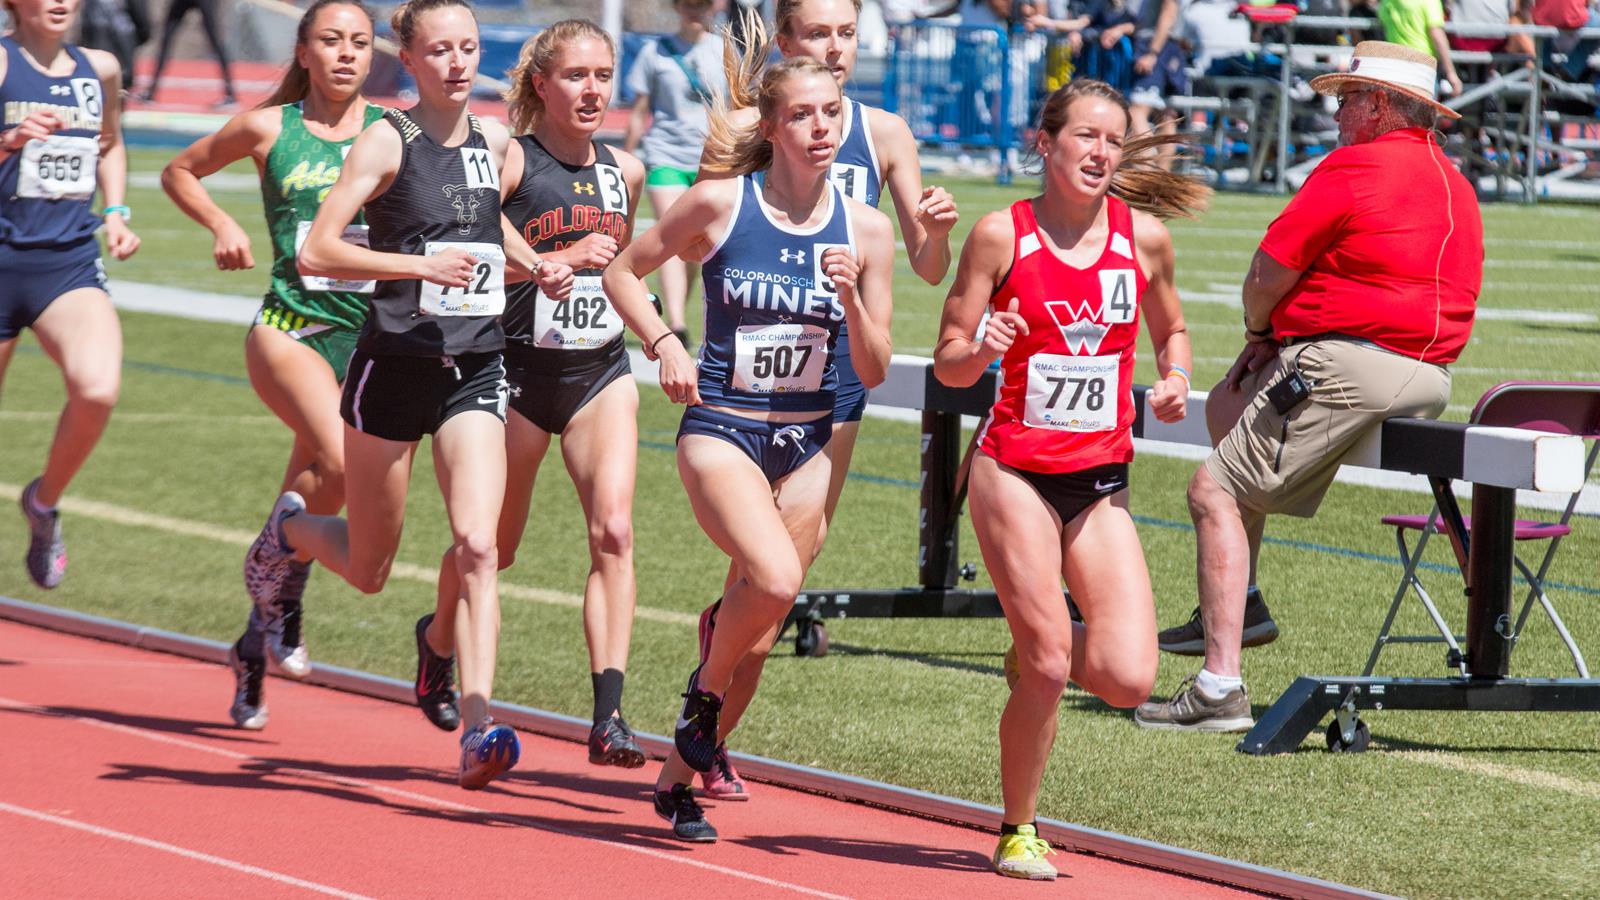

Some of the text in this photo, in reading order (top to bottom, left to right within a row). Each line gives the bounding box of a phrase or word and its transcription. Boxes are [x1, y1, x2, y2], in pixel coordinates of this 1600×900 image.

[82, 82, 100, 117] 8
[468, 152, 494, 185] 11
[836, 167, 855, 198] 1
[603, 168, 624, 210] 3
[552, 296, 608, 330] 462
[723, 278, 846, 322] MINES
[1110, 274, 1131, 320] 4
[742, 334, 766, 342] RMAC
[753, 345, 813, 379] 507
[1035, 362, 1059, 372] RMAC
[1045, 376, 1106, 412] 778
